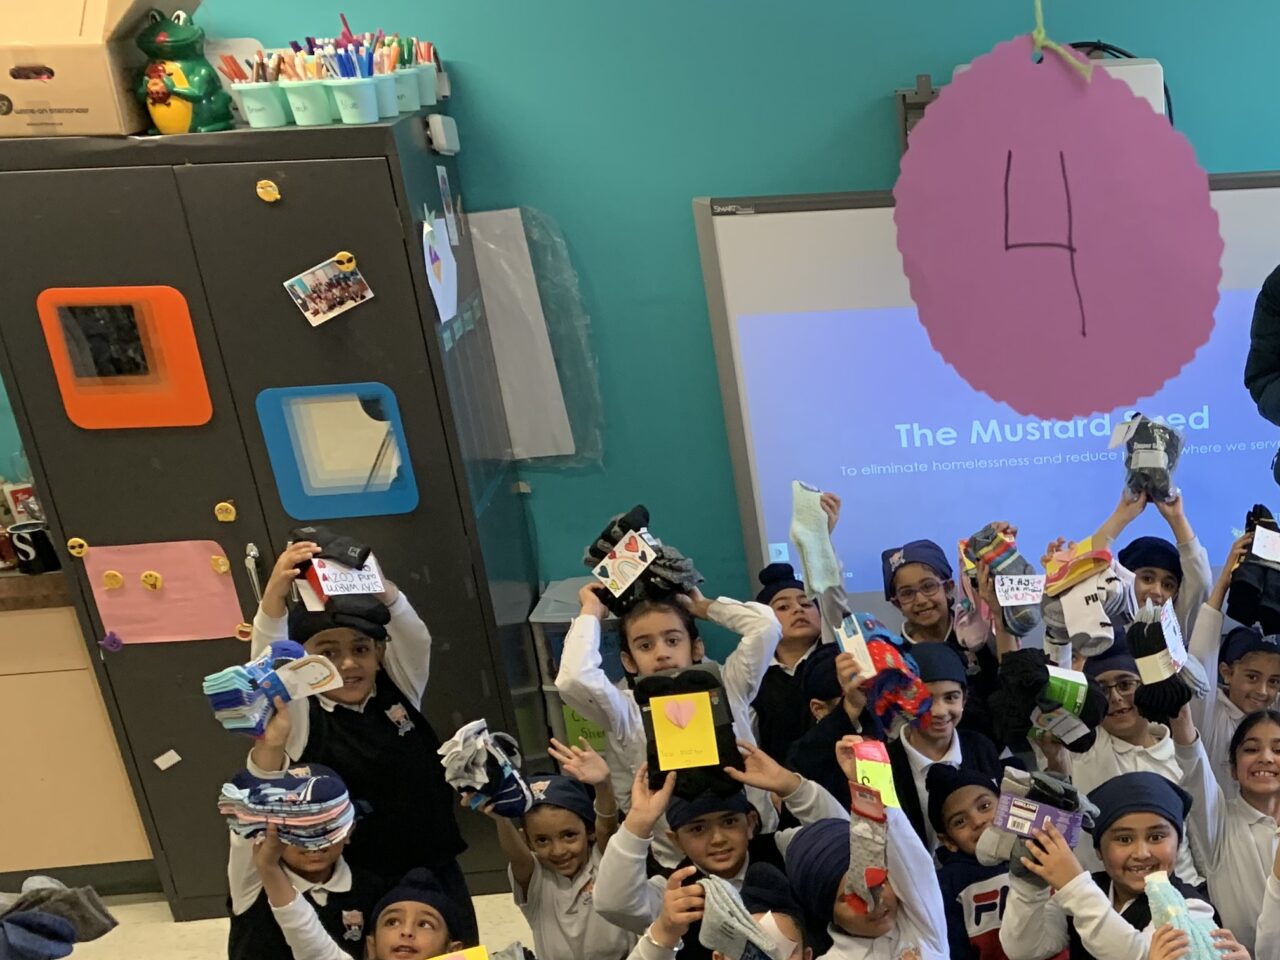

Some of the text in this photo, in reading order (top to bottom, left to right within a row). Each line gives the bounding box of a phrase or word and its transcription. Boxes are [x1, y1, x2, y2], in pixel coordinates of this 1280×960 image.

[1004, 149, 1087, 338] 4
[895, 423, 958, 448] The
[970, 412, 1111, 444] Mustard
[839, 465, 857, 477] To
[861, 460, 929, 476] eliminate
[932, 455, 1029, 472] homelessness
[1033, 452, 1063, 467] and
[1065, 449, 1118, 464] reduce
[1180, 441, 1223, 456] where
[1226, 442, 1247, 453] we
[13, 533, 36, 561] S
